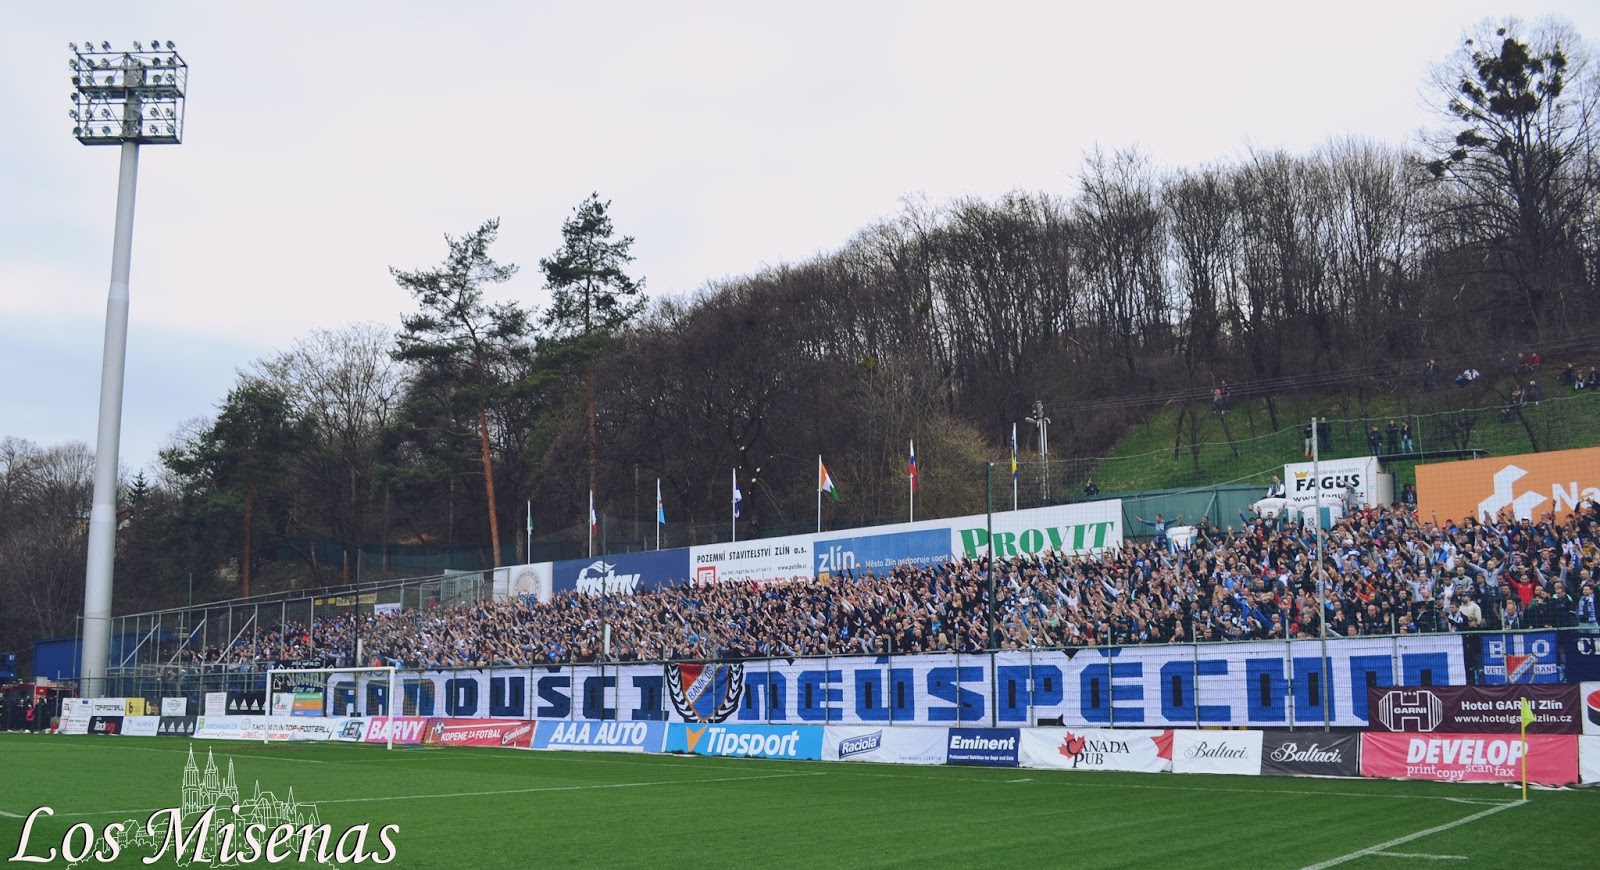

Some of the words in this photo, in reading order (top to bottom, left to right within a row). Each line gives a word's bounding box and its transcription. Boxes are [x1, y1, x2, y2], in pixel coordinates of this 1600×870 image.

[1296, 474, 1360, 492] FAGUS
[957, 521, 1115, 560] PROVIT
[696, 551, 726, 563] POZEMNÍ
[729, 546, 771, 560] STAVITELSTVÍ
[774, 544, 790, 556] ZLÍN
[884, 557, 897, 567] Zlín
[931, 554, 948, 563] sport
[1393, 707, 1428, 715] GARNI
[1461, 700, 1493, 711] Hotel
[1538, 699, 1563, 710] Zlín
[1454, 714, 1573, 725] www.hotelgaizlin.cz
[367, 720, 425, 741] BARVY
[440, 731, 469, 742] KOPEME
[475, 729, 501, 740] FOTBAL
[549, 722, 591, 745] AAA
[593, 721, 648, 745] AUTO
[705, 727, 800, 757] Tipsport
[841, 736, 877, 754] Raciola
[950, 735, 1016, 750] Eminent
[1066, 738, 1131, 755] CANADA
[1183, 740, 1247, 759] Baltaci
[1072, 752, 1104, 768] PUB
[1270, 742, 1340, 763] Baltaci
[1406, 738, 1529, 766] DEVELOP
[1406, 763, 1437, 777] print
[1436, 765, 1466, 781] copy
[1465, 762, 1493, 774] scan
[1494, 764, 1516, 777] fax
